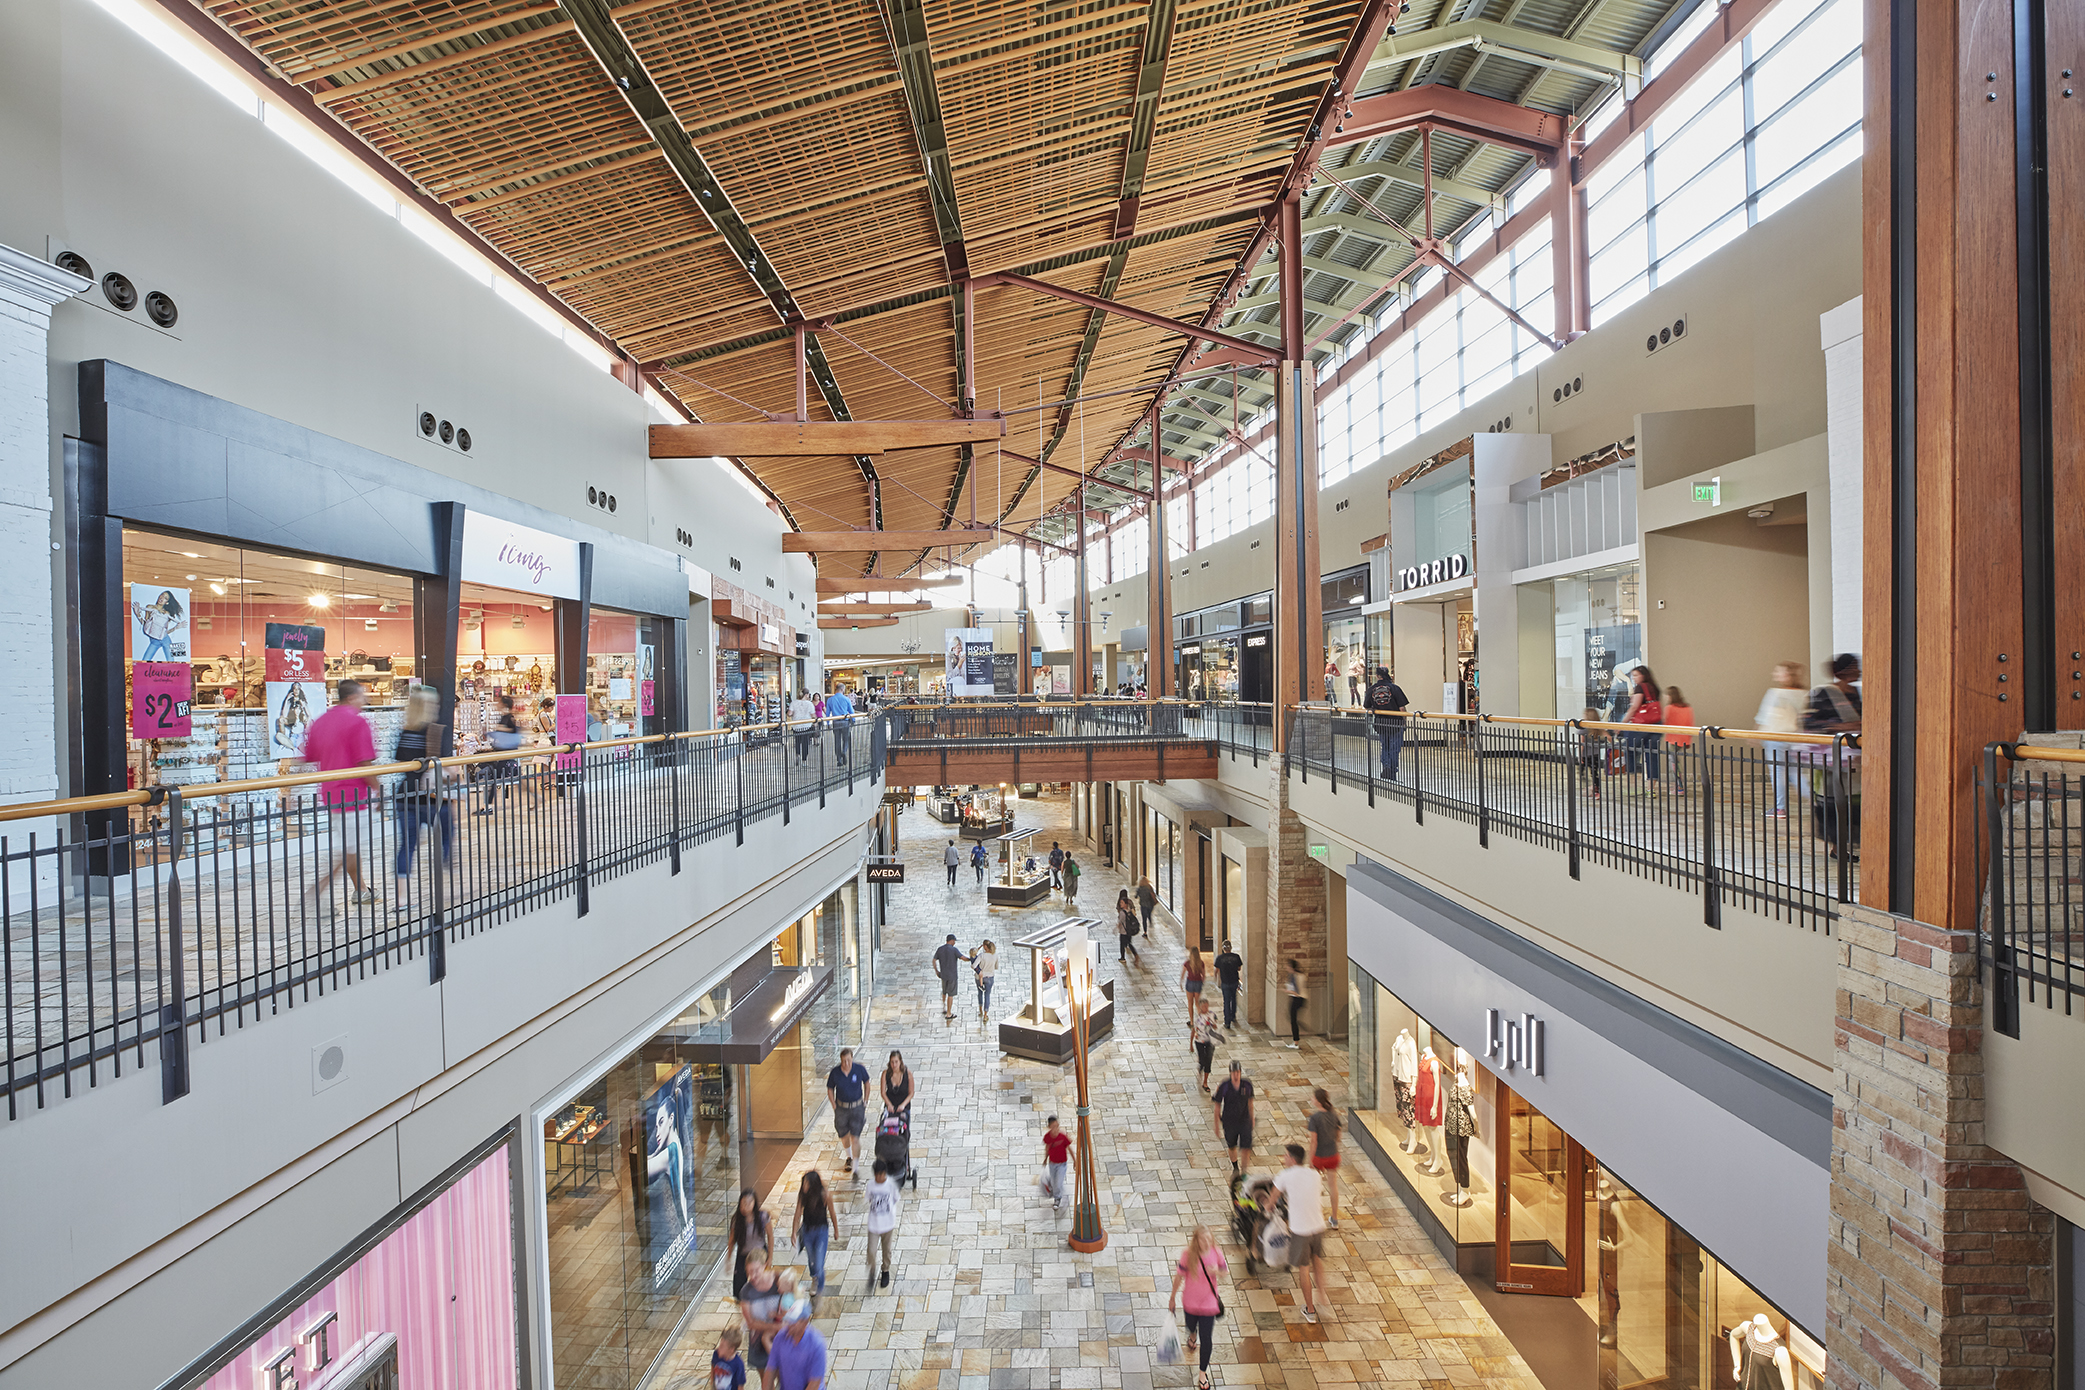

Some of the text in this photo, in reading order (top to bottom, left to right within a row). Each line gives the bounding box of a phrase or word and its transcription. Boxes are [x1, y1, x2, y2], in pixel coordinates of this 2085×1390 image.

[1695, 486, 1714, 500] EXIT
[1398, 553, 1468, 591] TORRID
[281, 628, 308, 649] jewelry
[1247, 637, 1266, 647] EXPRESS
[1589, 635, 1605, 645] MEET
[1588, 646, 1606, 657] YOUR
[284, 649, 304, 671] $5
[1589, 658, 1604, 669] NEW
[144, 665, 181, 678] clearance
[1589, 670, 1608, 680] JEANS
[145, 693, 173, 728] $2
[1311, 845, 1326, 856] EXIT
[869, 869, 902, 877] AVEDA
[784, 966, 814, 1006] AVEDA
[676, 1066, 692, 1085] AVEDA
[655, 1234, 682, 1275] BEAUTIFUL
